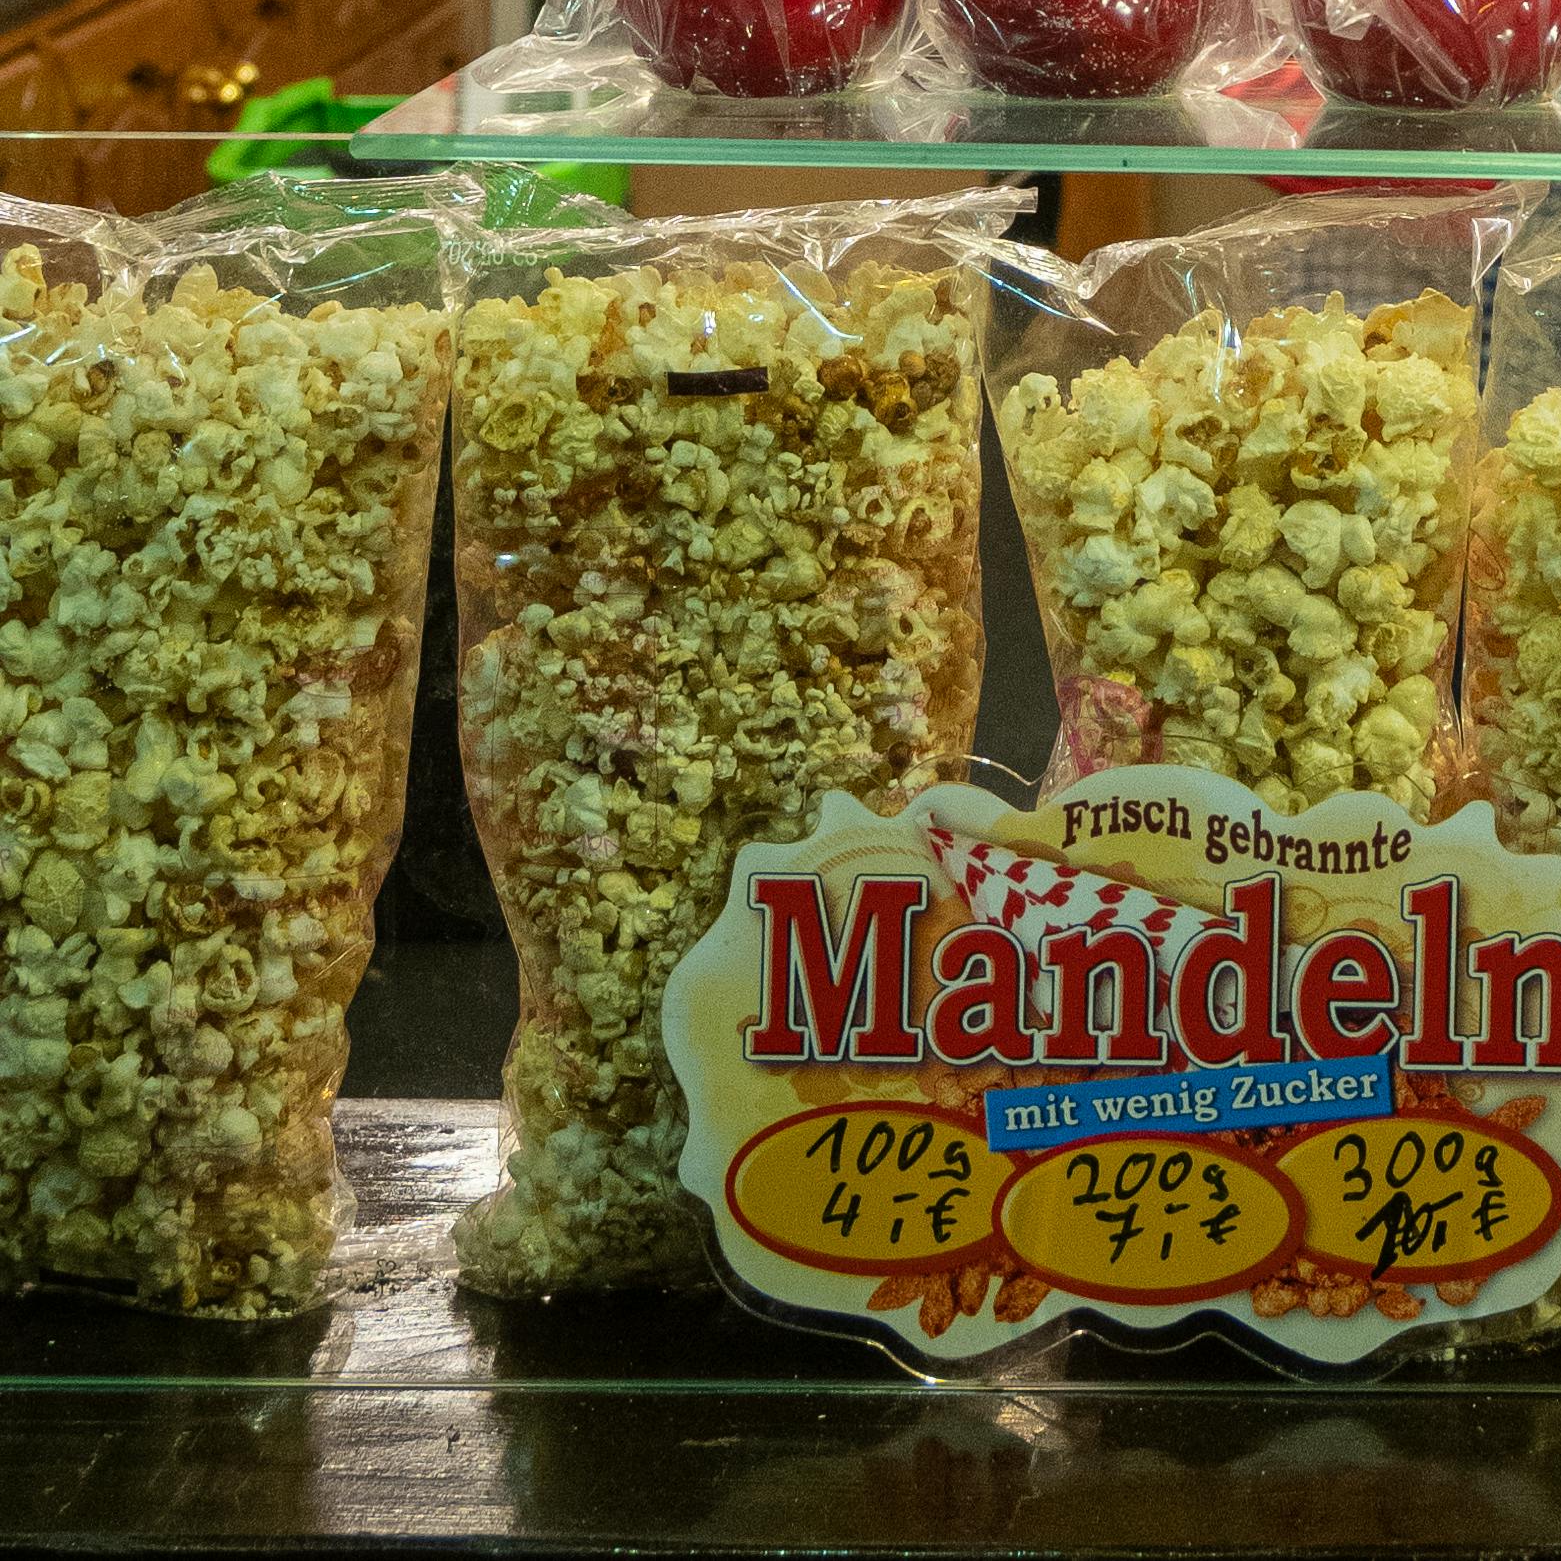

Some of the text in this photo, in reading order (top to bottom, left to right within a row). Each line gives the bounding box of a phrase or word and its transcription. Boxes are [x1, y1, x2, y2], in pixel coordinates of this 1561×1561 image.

[1061, 795, 1412, 876] Frisch gebrannte
[1004, 1068, 1379, 1132] mit wenig Zucker
